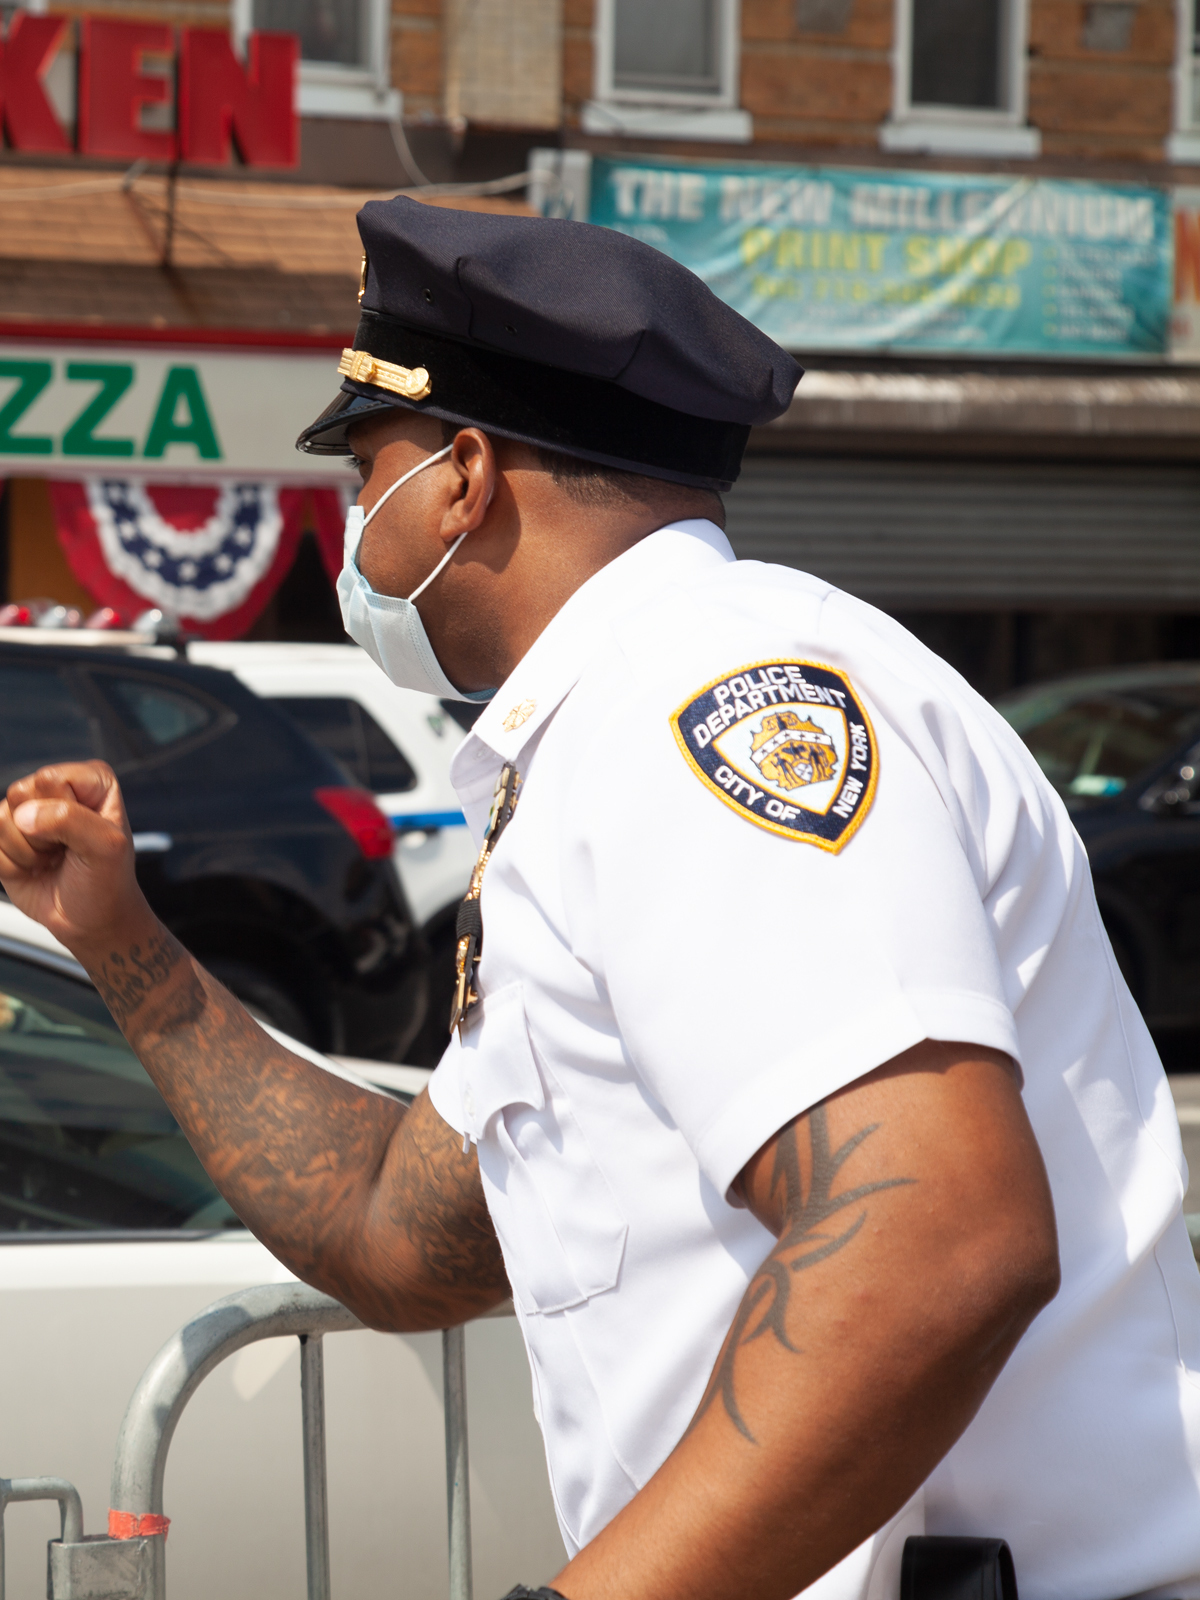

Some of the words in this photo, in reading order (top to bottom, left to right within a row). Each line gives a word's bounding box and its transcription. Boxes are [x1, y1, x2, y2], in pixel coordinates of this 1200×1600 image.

[612, 168, 706, 221] THE
[719, 174, 834, 225] NEW
[739, 226, 890, 272] PRINT
[904, 233, 1032, 279] SHOP
[713, 665, 806, 706] POLICE
[692, 683, 847, 749] DEPARTMENT
[714, 765, 765, 806] CITY
[765, 799, 801, 821] OF
[832, 776, 865, 819] NEW
[849, 721, 868, 772] YORK
